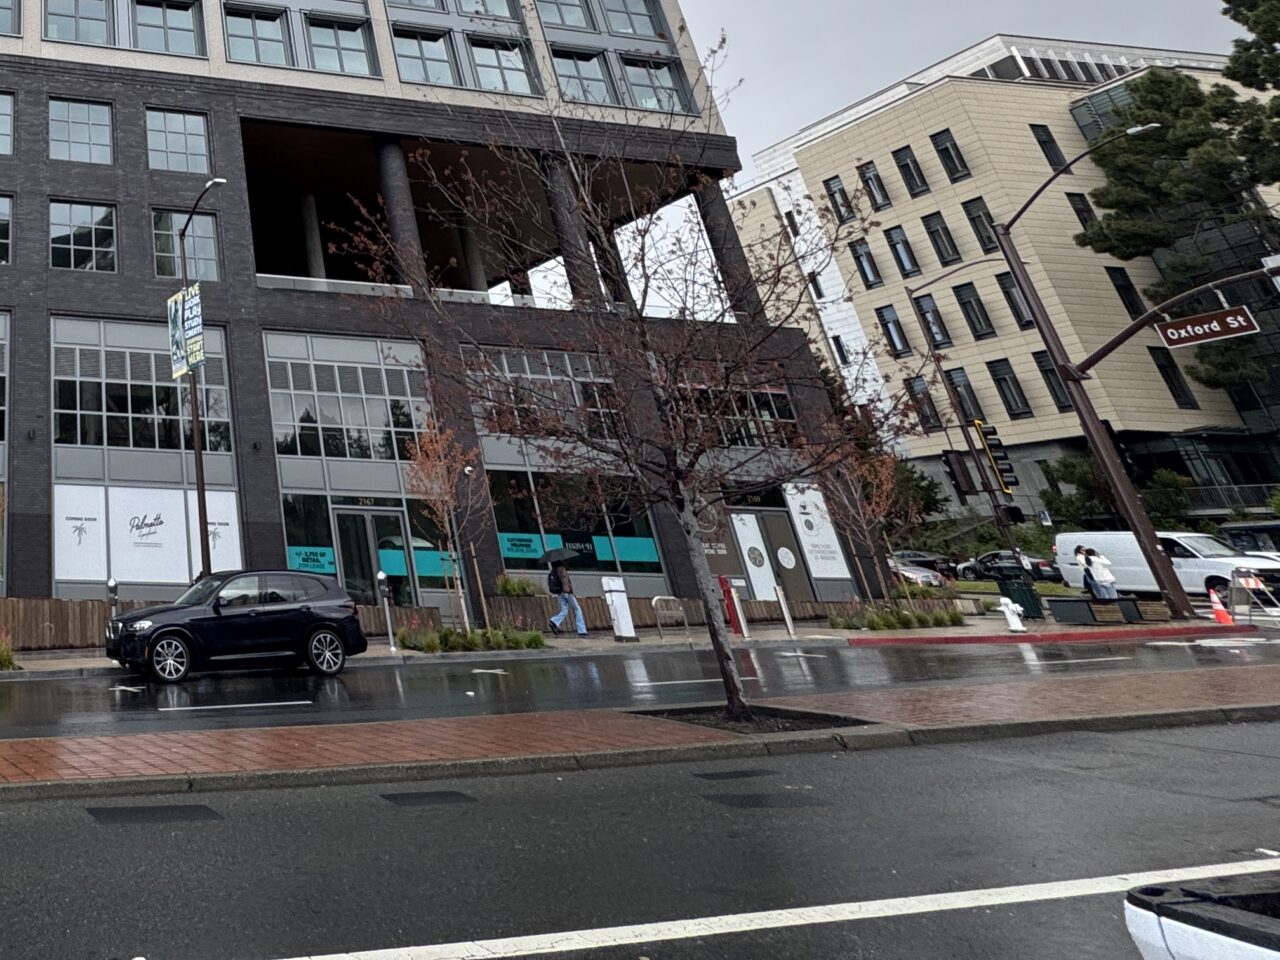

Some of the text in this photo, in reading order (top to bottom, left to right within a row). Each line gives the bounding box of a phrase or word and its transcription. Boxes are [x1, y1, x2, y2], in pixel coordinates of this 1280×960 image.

[185, 282, 200, 300] LIVE
[184, 303, 201, 320] PLAY
[185, 315, 202, 329] STUDY
[1167, 315, 1247, 339] Oxford St
[187, 341, 204, 355] START
[188, 349, 205, 365] HERE
[129, 512, 164, 534] Palmetto
